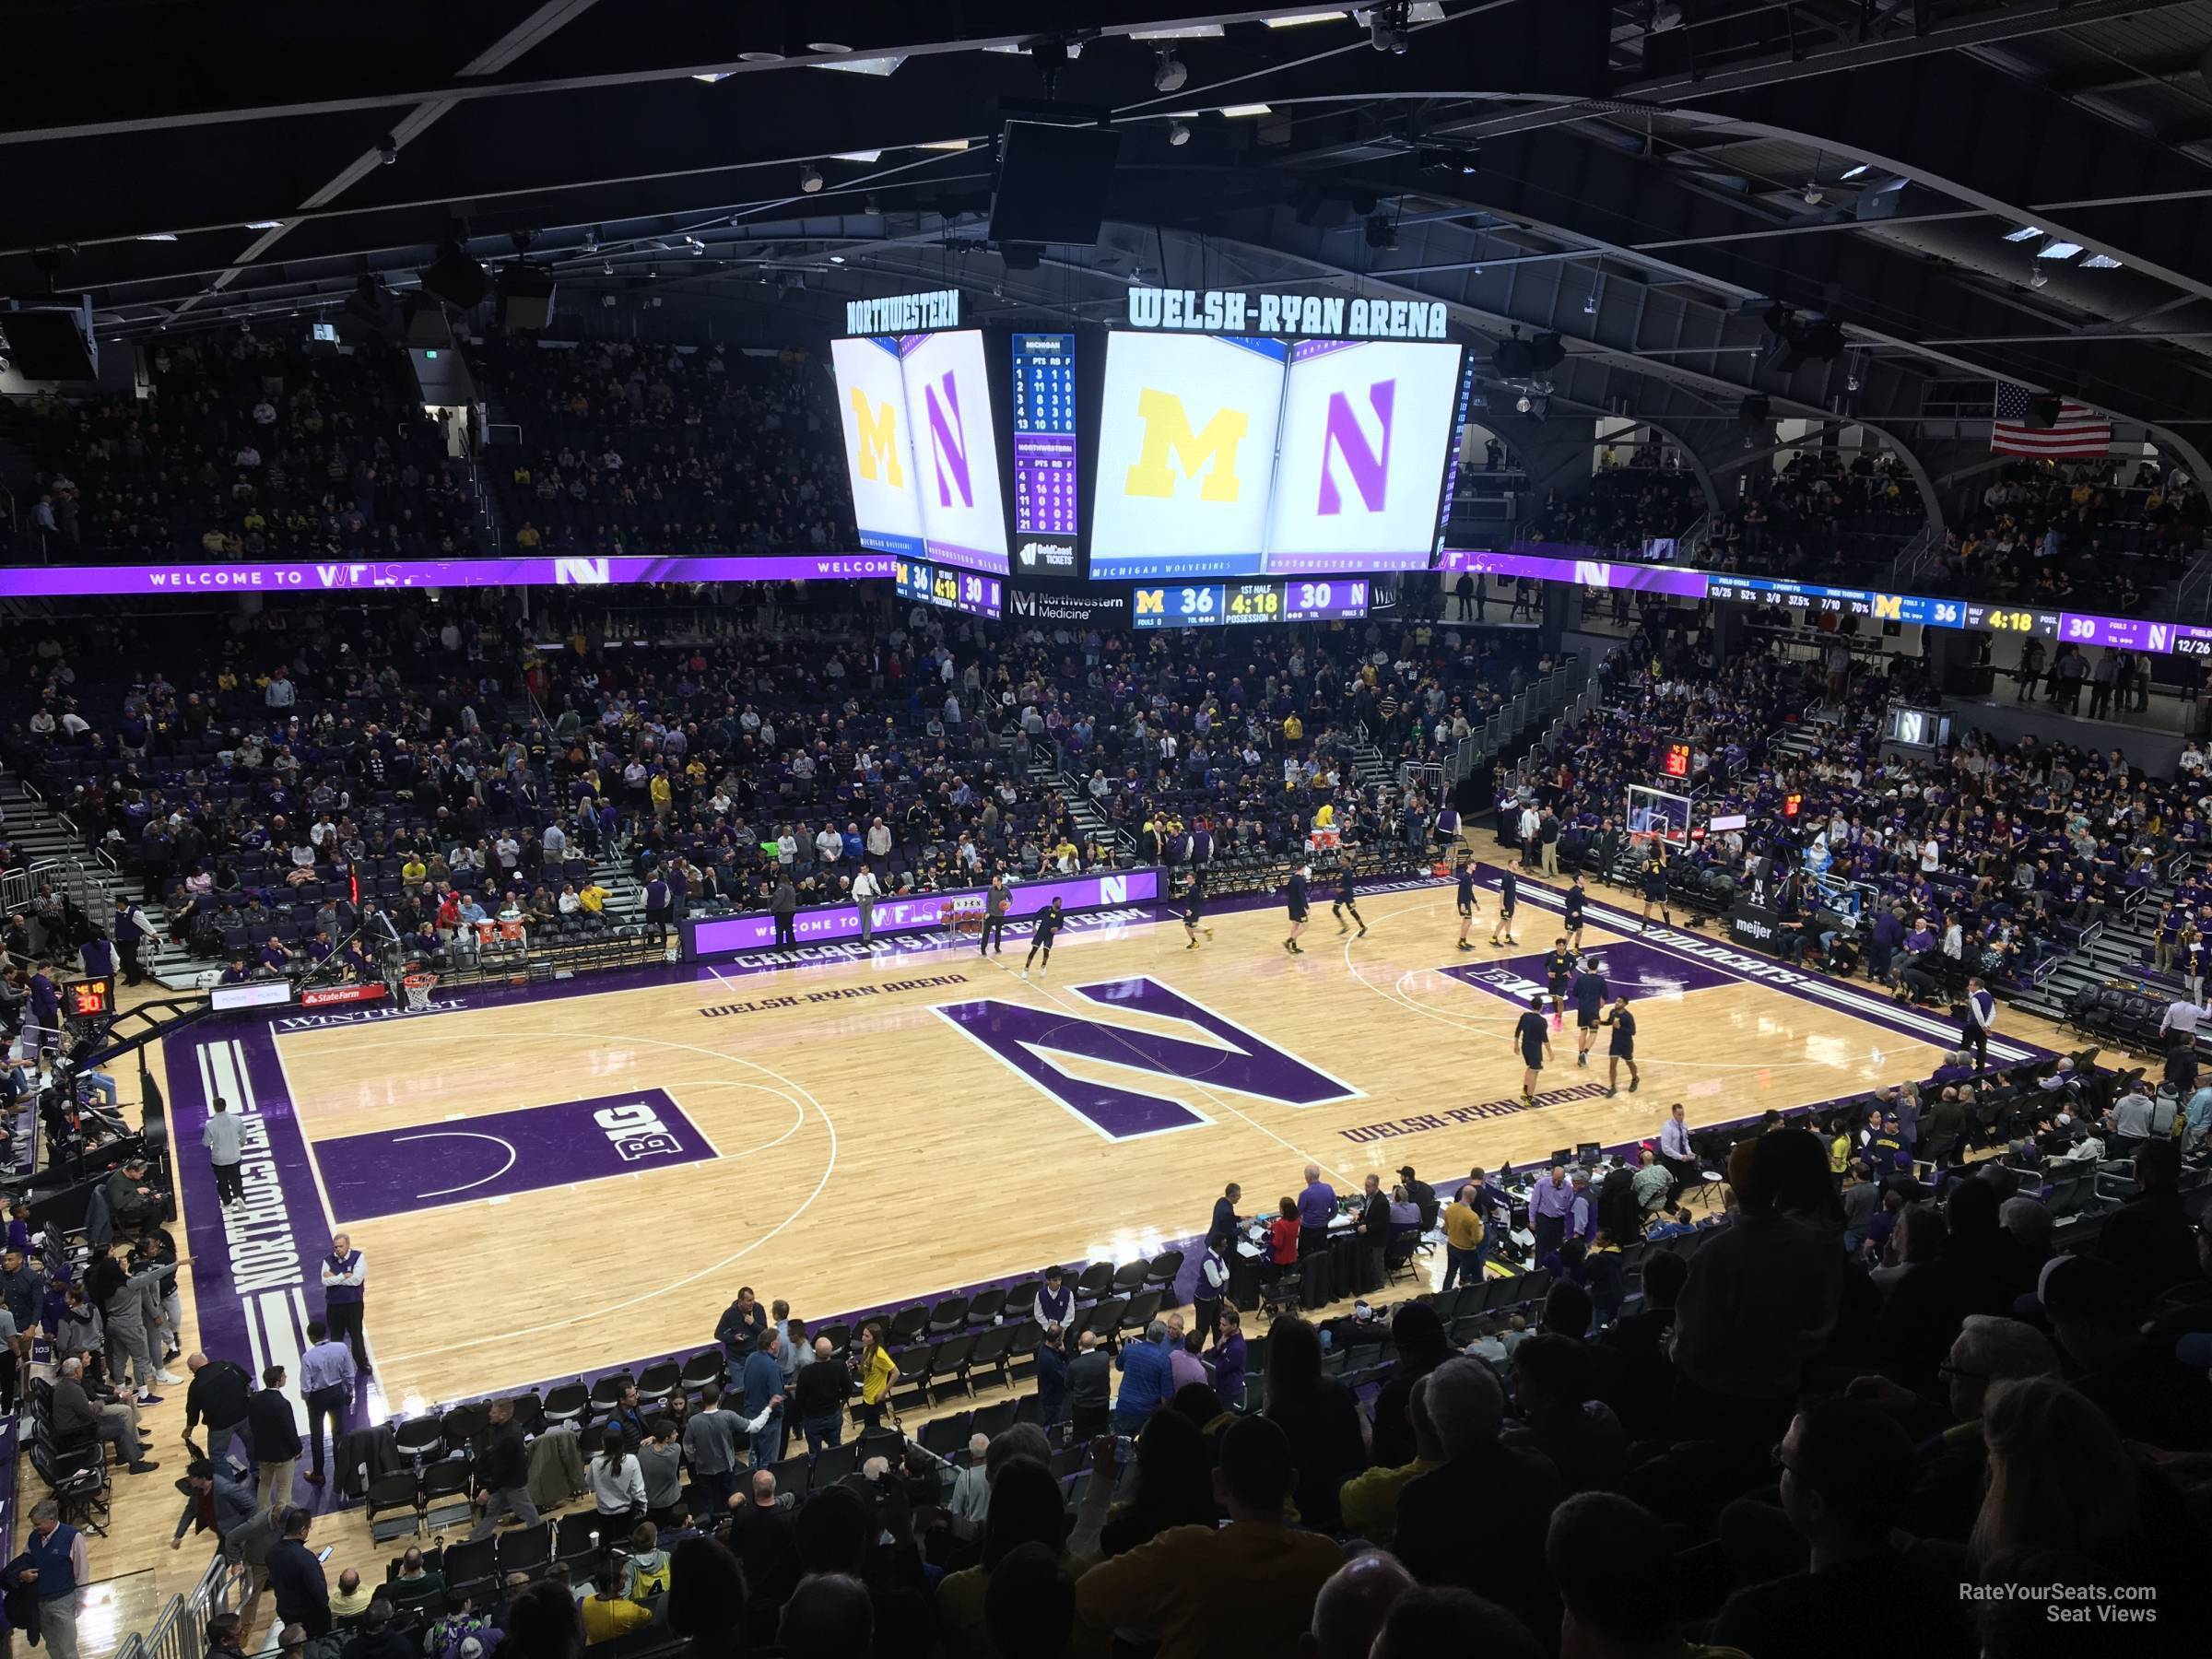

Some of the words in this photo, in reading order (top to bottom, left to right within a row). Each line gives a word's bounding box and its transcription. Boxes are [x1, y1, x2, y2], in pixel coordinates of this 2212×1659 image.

[847, 289, 959, 334] NORTHWESTERN
[1128, 287, 1344, 335] WELSH-RYAN
[1348, 300, 1447, 338] ARENA
[1016, 369, 1022, 379] 1
[1036, 369, 1042, 379] 3
[1052, 370, 1057, 380] 1
[1065, 370, 1070, 380] 1
[1017, 382, 1023, 392] 2
[1034, 382, 1044, 392] 11
[1052, 382, 1057, 393] 1
[1065, 382, 1071, 392] 0
[1017, 394, 1023, 404] 3
[1052, 394, 1058, 405] 3
[1065, 395, 1071, 406] 1
[1018, 406, 1024, 417] 4
[1037, 406, 1043, 418] 0
[1052, 407, 1058, 418] 3
[1065, 407, 1072, 418] 0
[1018, 419, 1028, 429] 13
[1035, 419, 1046, 429] 10
[1053, 420, 1058, 430] 1
[1065, 420, 1072, 430] 0
[850, 386, 903, 488] M
[924, 370, 974, 508] N
[1124, 386, 1249, 503] M
[1317, 378, 1396, 515] N
[1018, 471, 1026, 480] 4
[1053, 472, 1060, 482] 2
[1065, 473, 1073, 483] 3
[1019, 483, 1026, 493] 5
[1036, 484, 1047, 494] 16
[1053, 485, 1060, 495] 4
[1066, 485, 1073, 495] 0
[1019, 495, 1030, 505] 11
[1039, 496, 1045, 506] 0
[1053, 497, 1060, 506] 3
[1066, 497, 1072, 507] 1
[1019, 508, 1030, 517] 14
[1039, 508, 1045, 518] 4
[1053, 509, 1061, 519] 0
[1066, 509, 1073, 519] 2
[1019, 520, 1030, 529] 21
[1039, 520, 1046, 530] 0
[1054, 521, 1061, 531] 2
[1067, 522, 1073, 531] 0
[818, 561, 897, 573] WELCOME
[1046, 555, 1073, 565] TICKETS
[1270, 559, 1363, 569] NORTHWESTERN
[149, 572, 262, 585] WELCOME
[274, 571, 302, 583] TO
[913, 566, 928, 590] 36
[1092, 565, 1158, 577] MICHIGAN
[1165, 562, 1231, 573] WOLVERINES
[935, 578, 956, 600] 4:18
[966, 576, 982, 603] 30
[991, 582, 999, 606] N
[1241, 585, 1253, 594] 1ST
[1253, 584, 1272, 594] HALF
[1300, 582, 1331, 608] 30
[1351, 583, 1364, 605] N
[1712, 587, 1732, 598] 13/25
[1741, 589, 1757, 600] 52%
[1040, 593, 1123, 607] Northwestern
[1135, 590, 1164, 613] M
[1180, 587, 1213, 613] 36
[1230, 593, 1278, 614] 4:18
[1766, 593, 1781, 604] 3/8
[1788, 594, 1810, 606] 37.5%
[1821, 599, 1841, 610] 7/10
[1852, 602, 1869, 614] 70%
[1875, 594, 1902, 619] M
[1039, 607, 1089, 619] Medicine
[1226, 613, 1268, 624] POSSESSION
[1935, 604, 1957, 622] 36
[1969, 607, 1983, 616] HALF
[1157, 618, 1162, 626] 0
[1989, 610, 2032, 631] 4:18
[2069, 618, 2095, 639] 30
[2147, 624, 2167, 651] N
[2178, 640, 2211, 655] 12/26
[1100, 876, 1126, 904] N
[1754, 878, 1763, 893] N
[841, 917, 858, 928] TO
[1064, 907, 1152, 927] TEAM
[1736, 919, 1772, 939] meijer
[1642, 929, 1809, 983] WILDCATS
[77, 995, 100, 1012] 30
[697, 985, 879, 1018] WELSH-RYAN
[881, 974, 969, 993] ARENA
[924, 974, 1370, 1144] N
[1337, 1098, 1526, 1143] WELSH-RYAN
